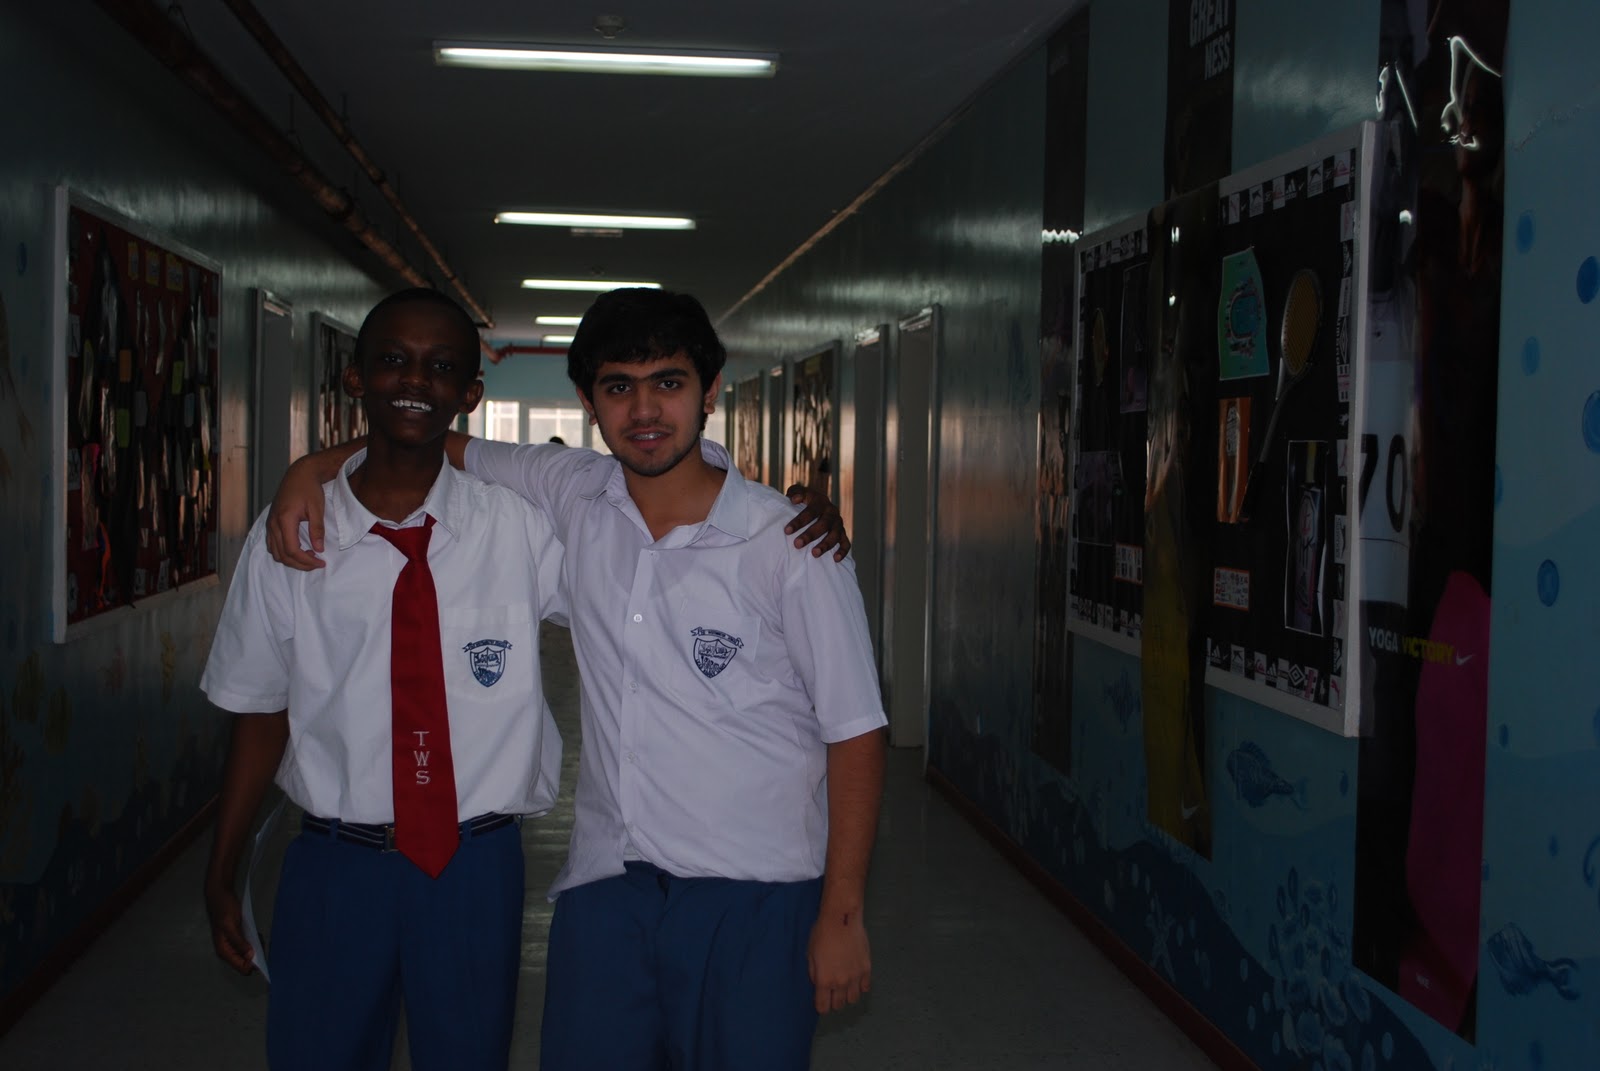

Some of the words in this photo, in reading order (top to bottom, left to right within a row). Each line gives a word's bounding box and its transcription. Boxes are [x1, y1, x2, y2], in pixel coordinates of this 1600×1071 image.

[1204, 31, 1231, 80] NESS
[1368, 626, 1399, 653] YOGA
[1401, 635, 1455, 665] VICTORY
[412, 730, 431, 785] TWS
